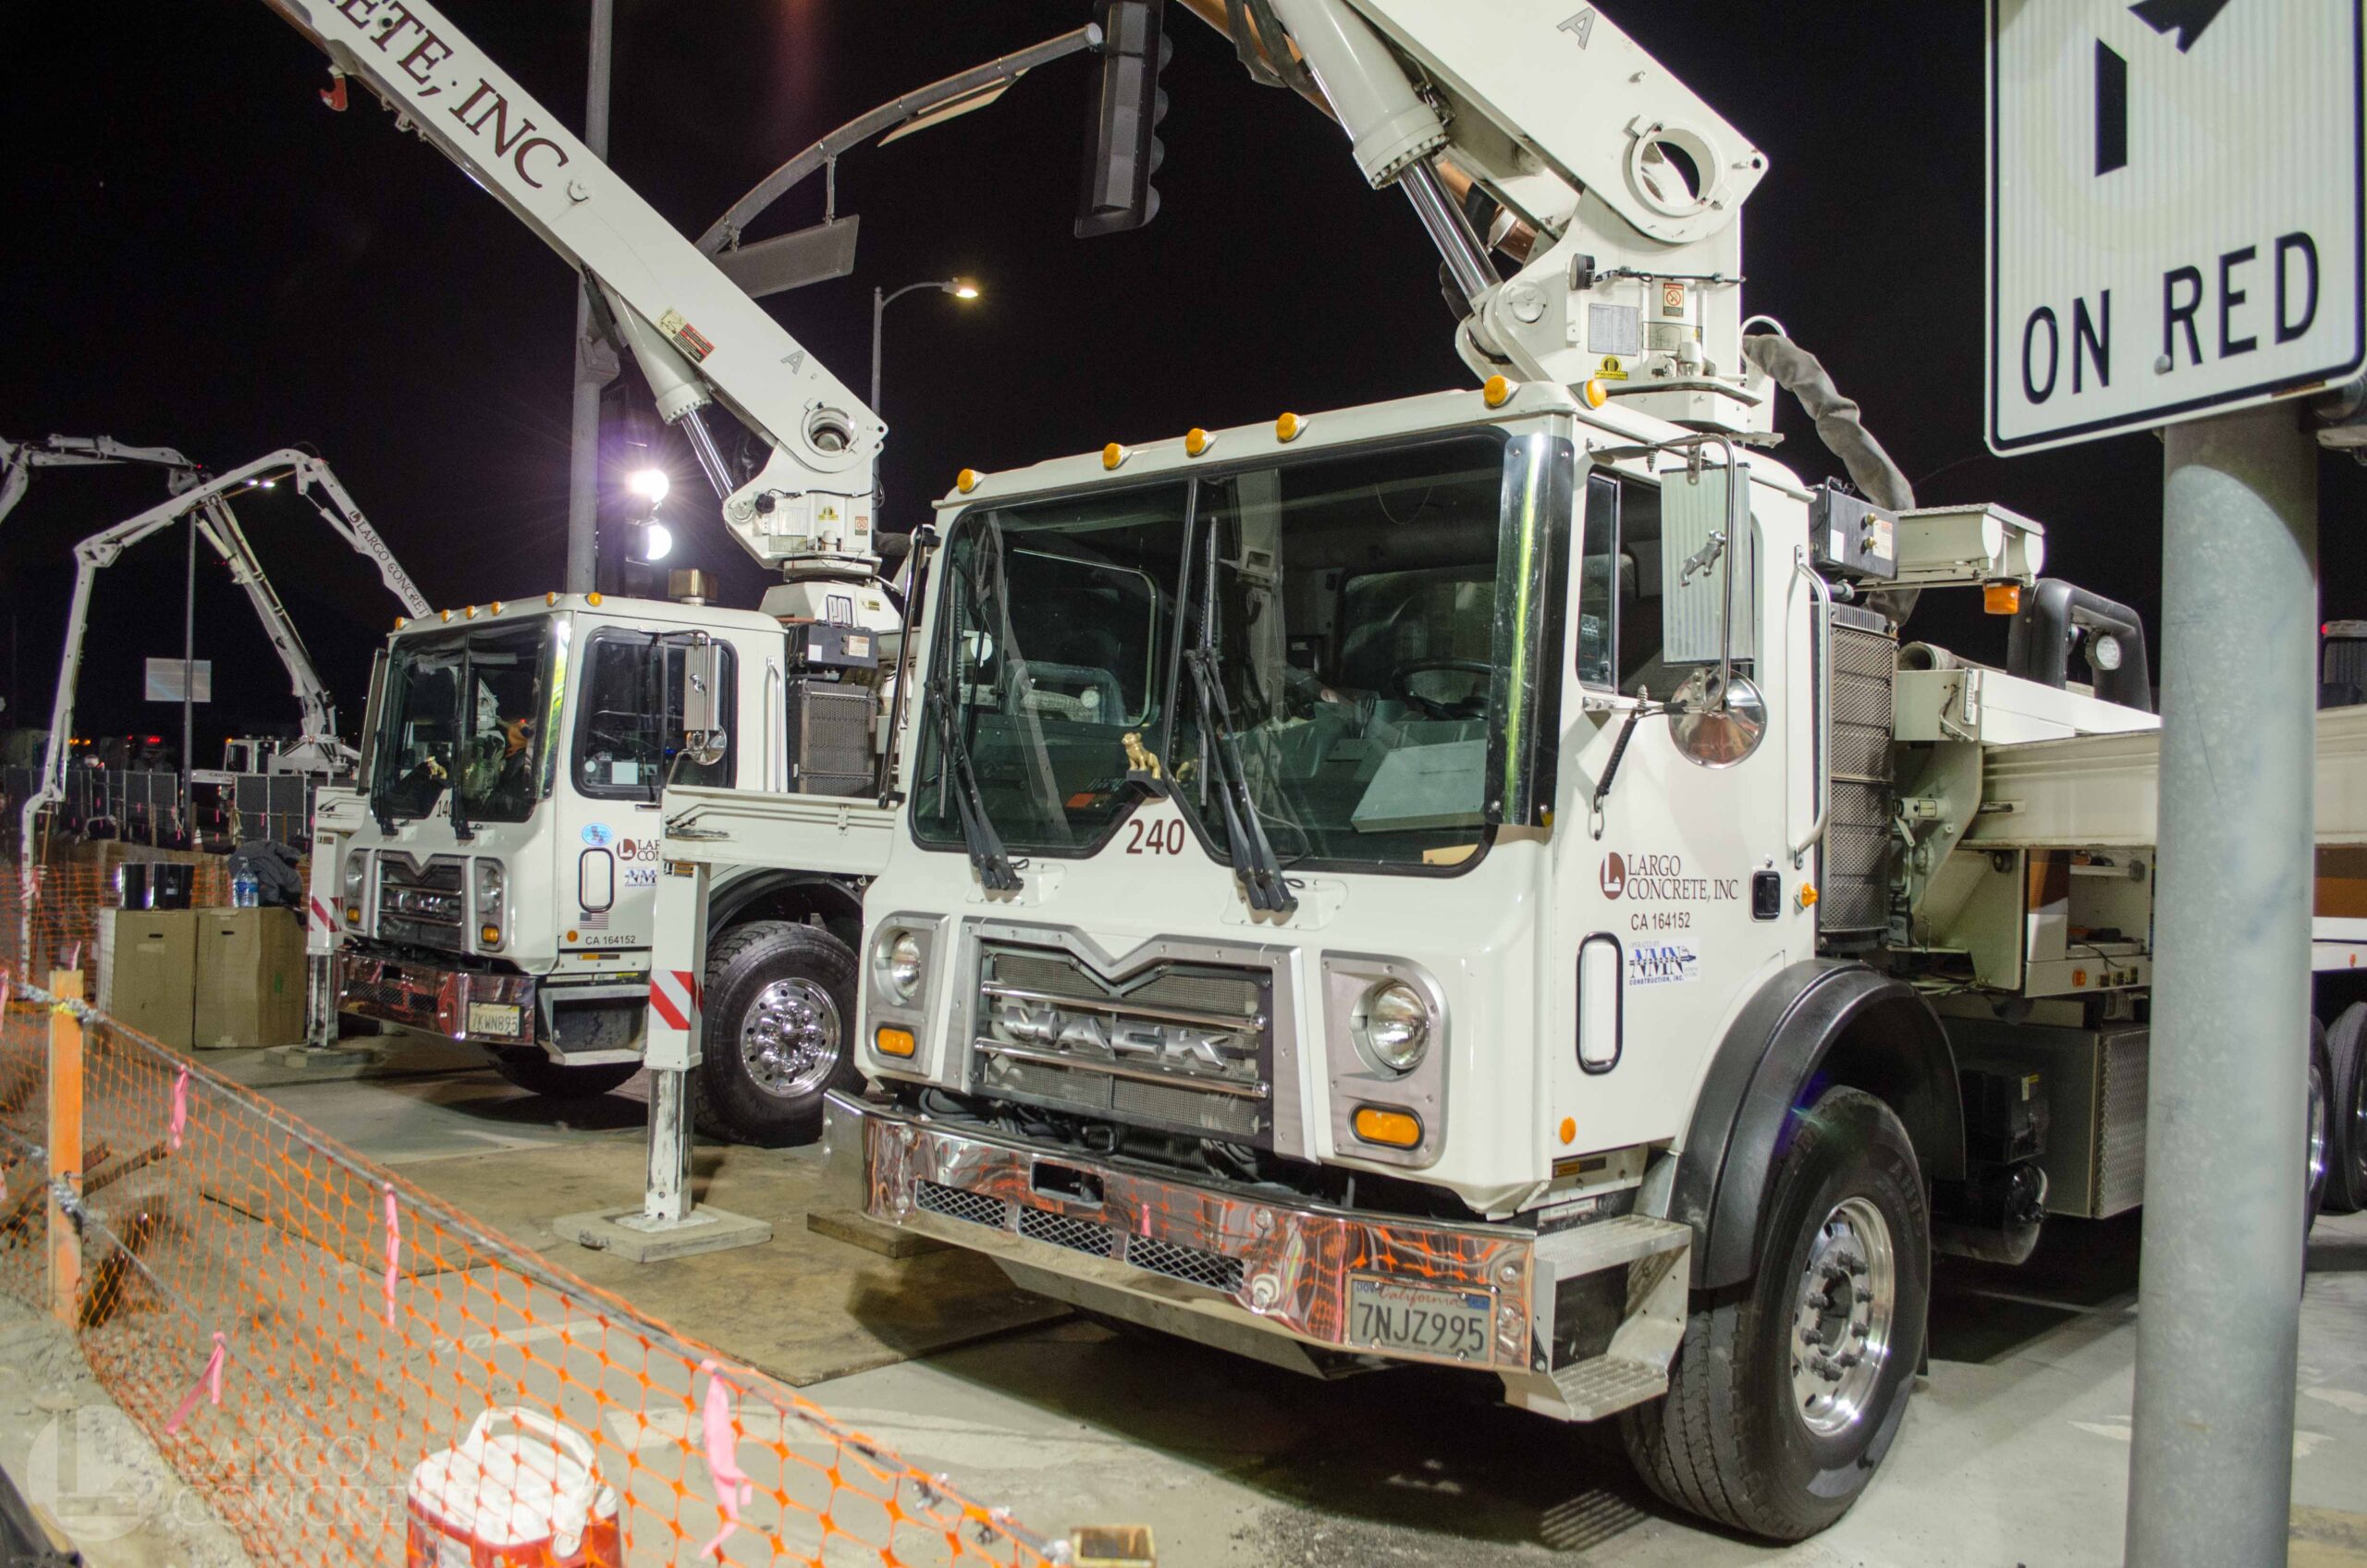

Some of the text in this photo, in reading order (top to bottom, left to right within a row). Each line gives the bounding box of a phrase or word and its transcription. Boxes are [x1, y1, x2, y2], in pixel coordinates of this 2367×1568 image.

[1556, 6, 1596, 50] A
[324, 0, 570, 189] ETE, INC
[2021, 231, 2320, 405] ON RED
[780, 349, 806, 374] A
[357, 521, 390, 561] LARGO
[1126, 818, 1185, 855] 240
[1627, 853, 1681, 876] LARGO
[1627, 877, 1738, 903] CONCRETE, INC
[1631, 912, 1690, 931] CA 164152
[585, 935, 636, 945] CA 164152
[1630, 945, 1685, 978] NMN
[1003, 1005, 1228, 1072] MACK
[1378, 1283, 1463, 1308] California
[1357, 1302, 1485, 1352] 7NJZ995
